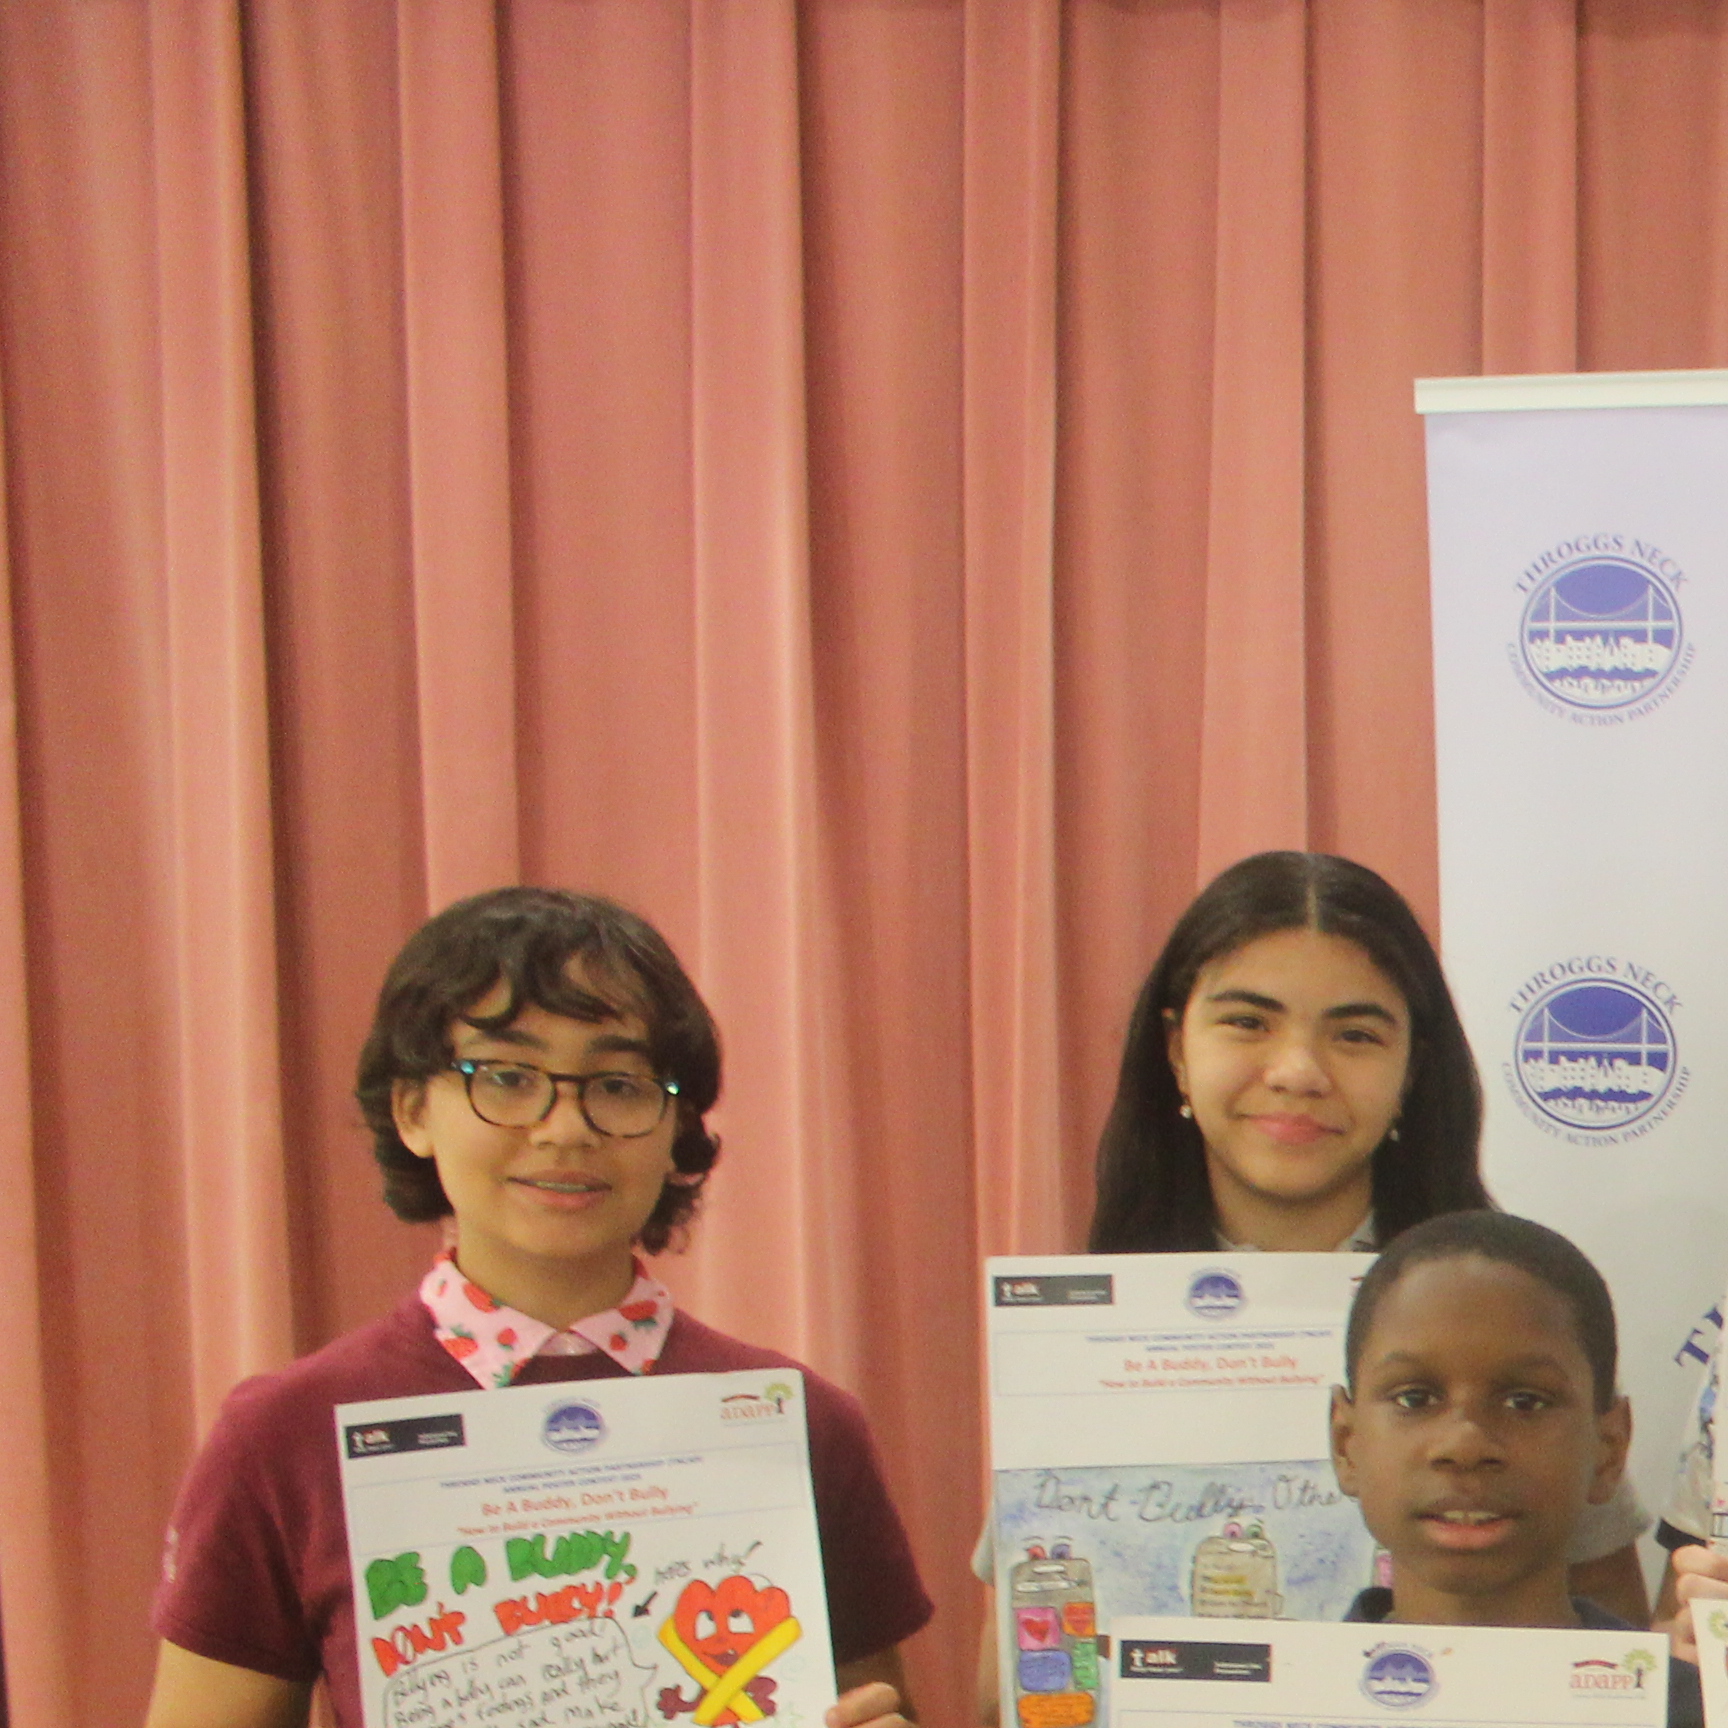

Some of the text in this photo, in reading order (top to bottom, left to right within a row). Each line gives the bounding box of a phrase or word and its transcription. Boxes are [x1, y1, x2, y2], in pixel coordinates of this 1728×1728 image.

[1515, 534, 1692, 594] THROGGS NECK
[1509, 956, 1685, 1017] THROGGS NECK
[365, 1551, 428, 1620] BE
